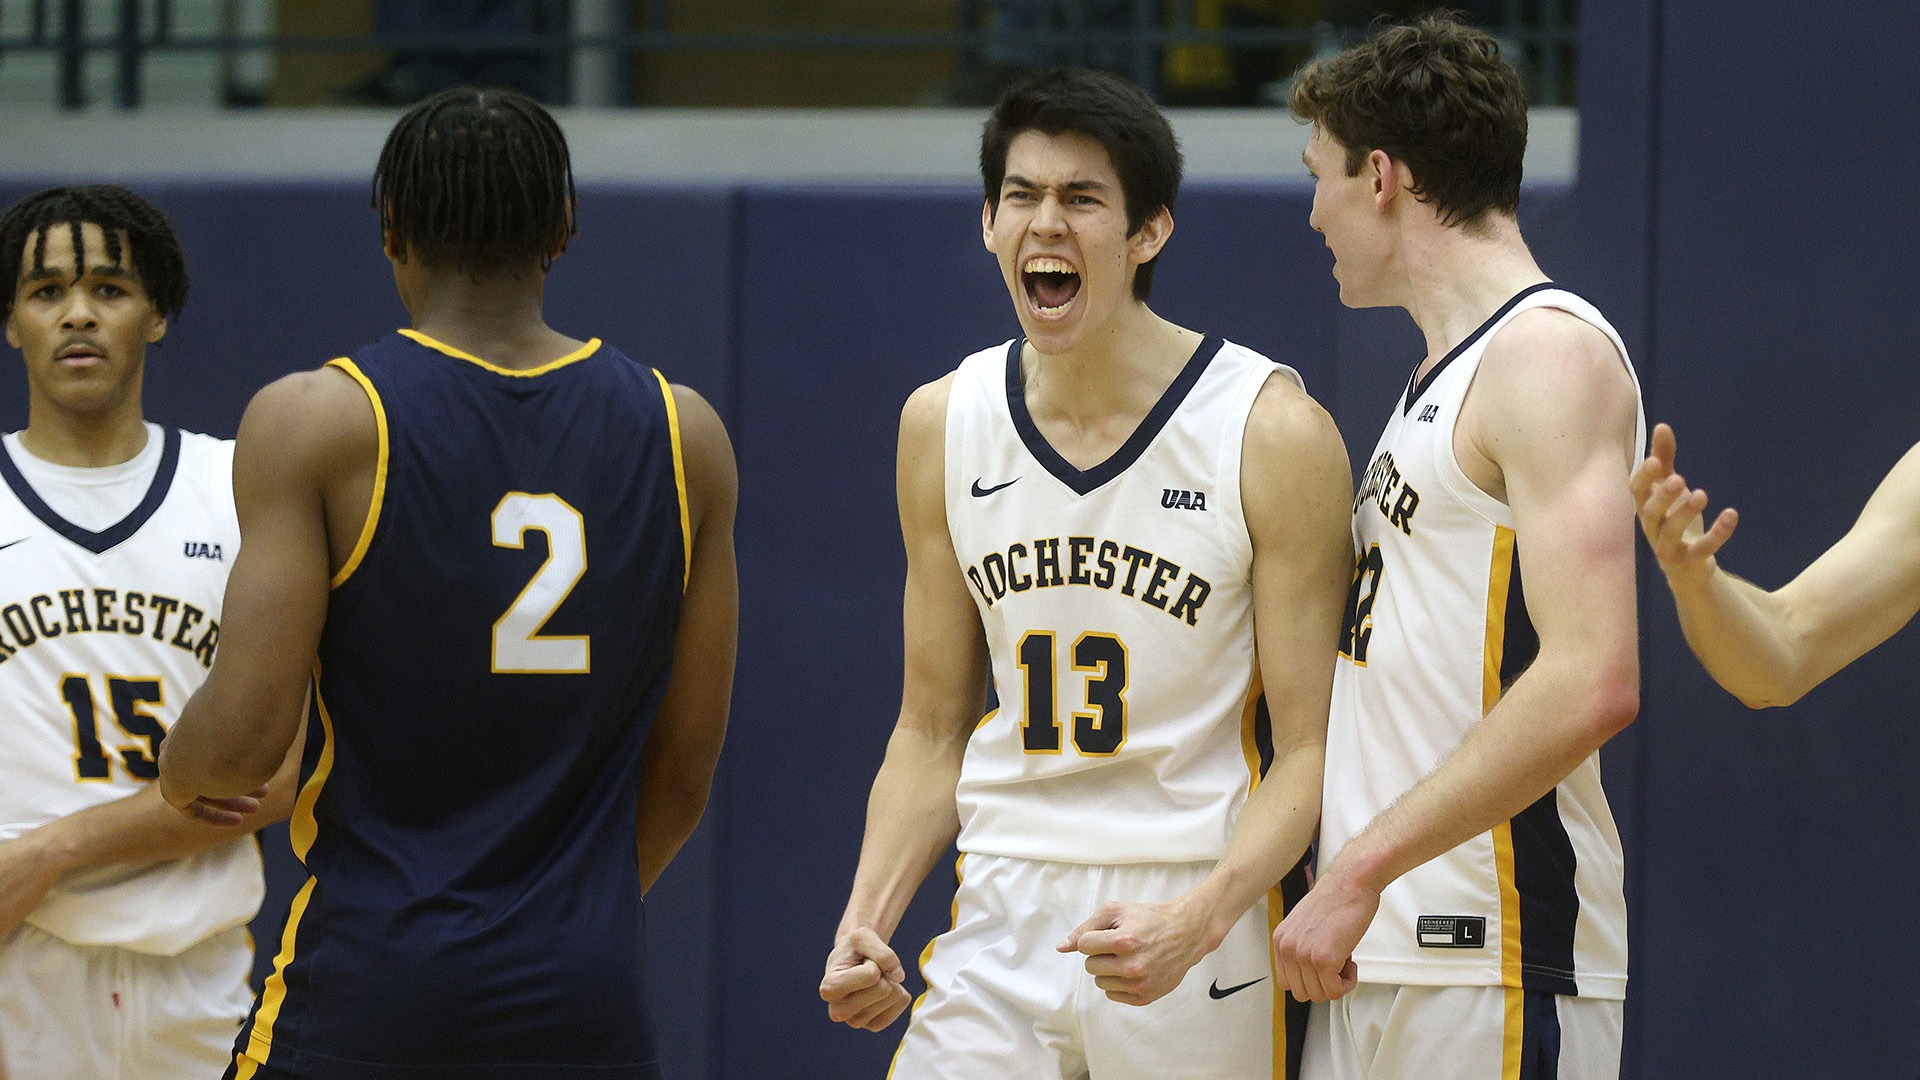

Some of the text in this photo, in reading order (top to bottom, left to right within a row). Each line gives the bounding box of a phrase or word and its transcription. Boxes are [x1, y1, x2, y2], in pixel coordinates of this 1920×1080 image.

[1160, 488, 1207, 511] UAA
[1351, 450, 1420, 537] OCHESTER
[183, 542, 223, 562] UAA
[490, 490, 590, 674] 2
[967, 536, 1212, 628] ROCHESTER
[58, 672, 168, 783] 15
[1016, 629, 1129, 757] 13
[1464, 925, 1473, 939] L
